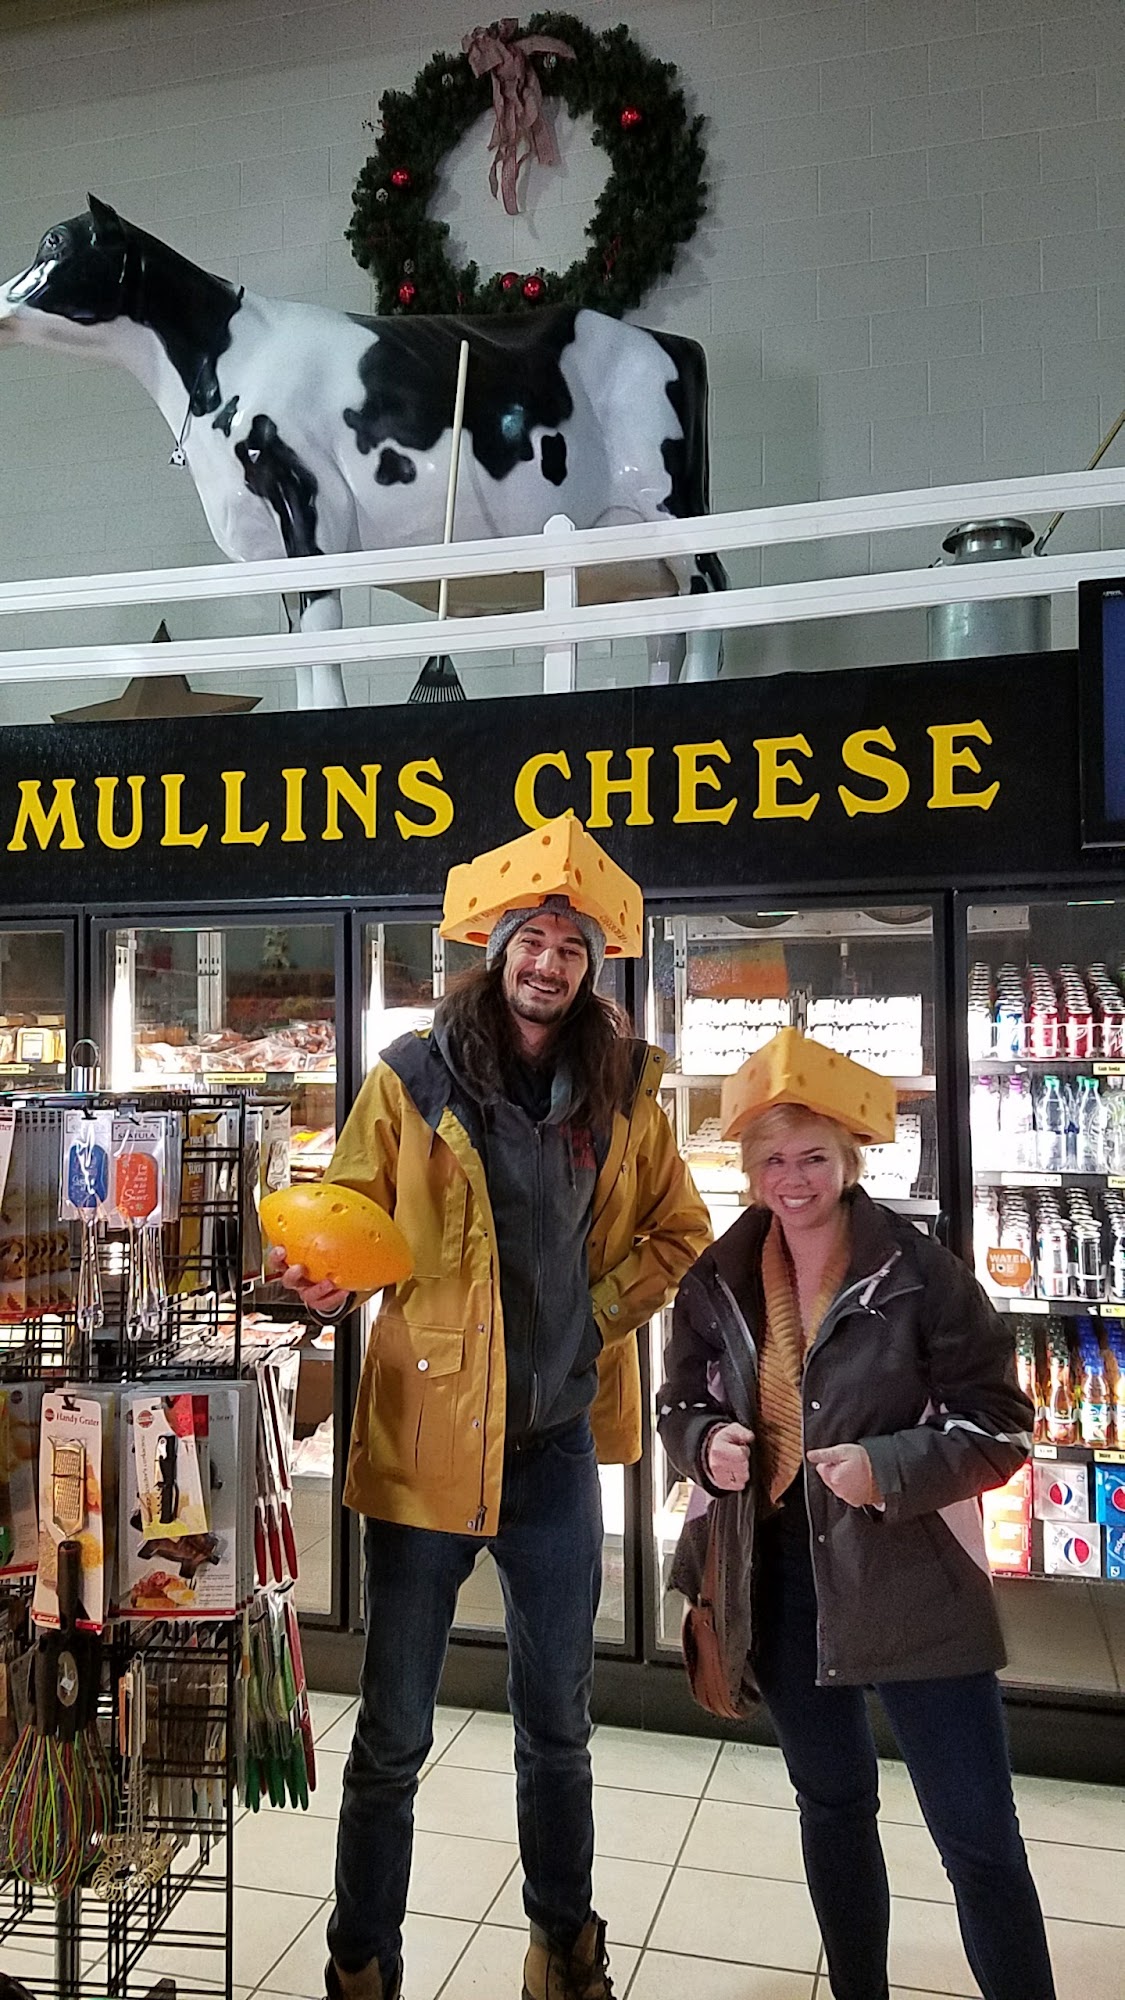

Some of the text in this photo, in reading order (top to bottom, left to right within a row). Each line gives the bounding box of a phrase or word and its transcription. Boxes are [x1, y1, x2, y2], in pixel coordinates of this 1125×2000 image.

[7, 719, 1001, 852] MULLINS CHEESE
[989, 1253, 1028, 1265] WATER
[990, 1263, 1015, 1274] JOE
[56, 1412, 78, 1425] Handy
[79, 1416, 99, 1426] Grater
